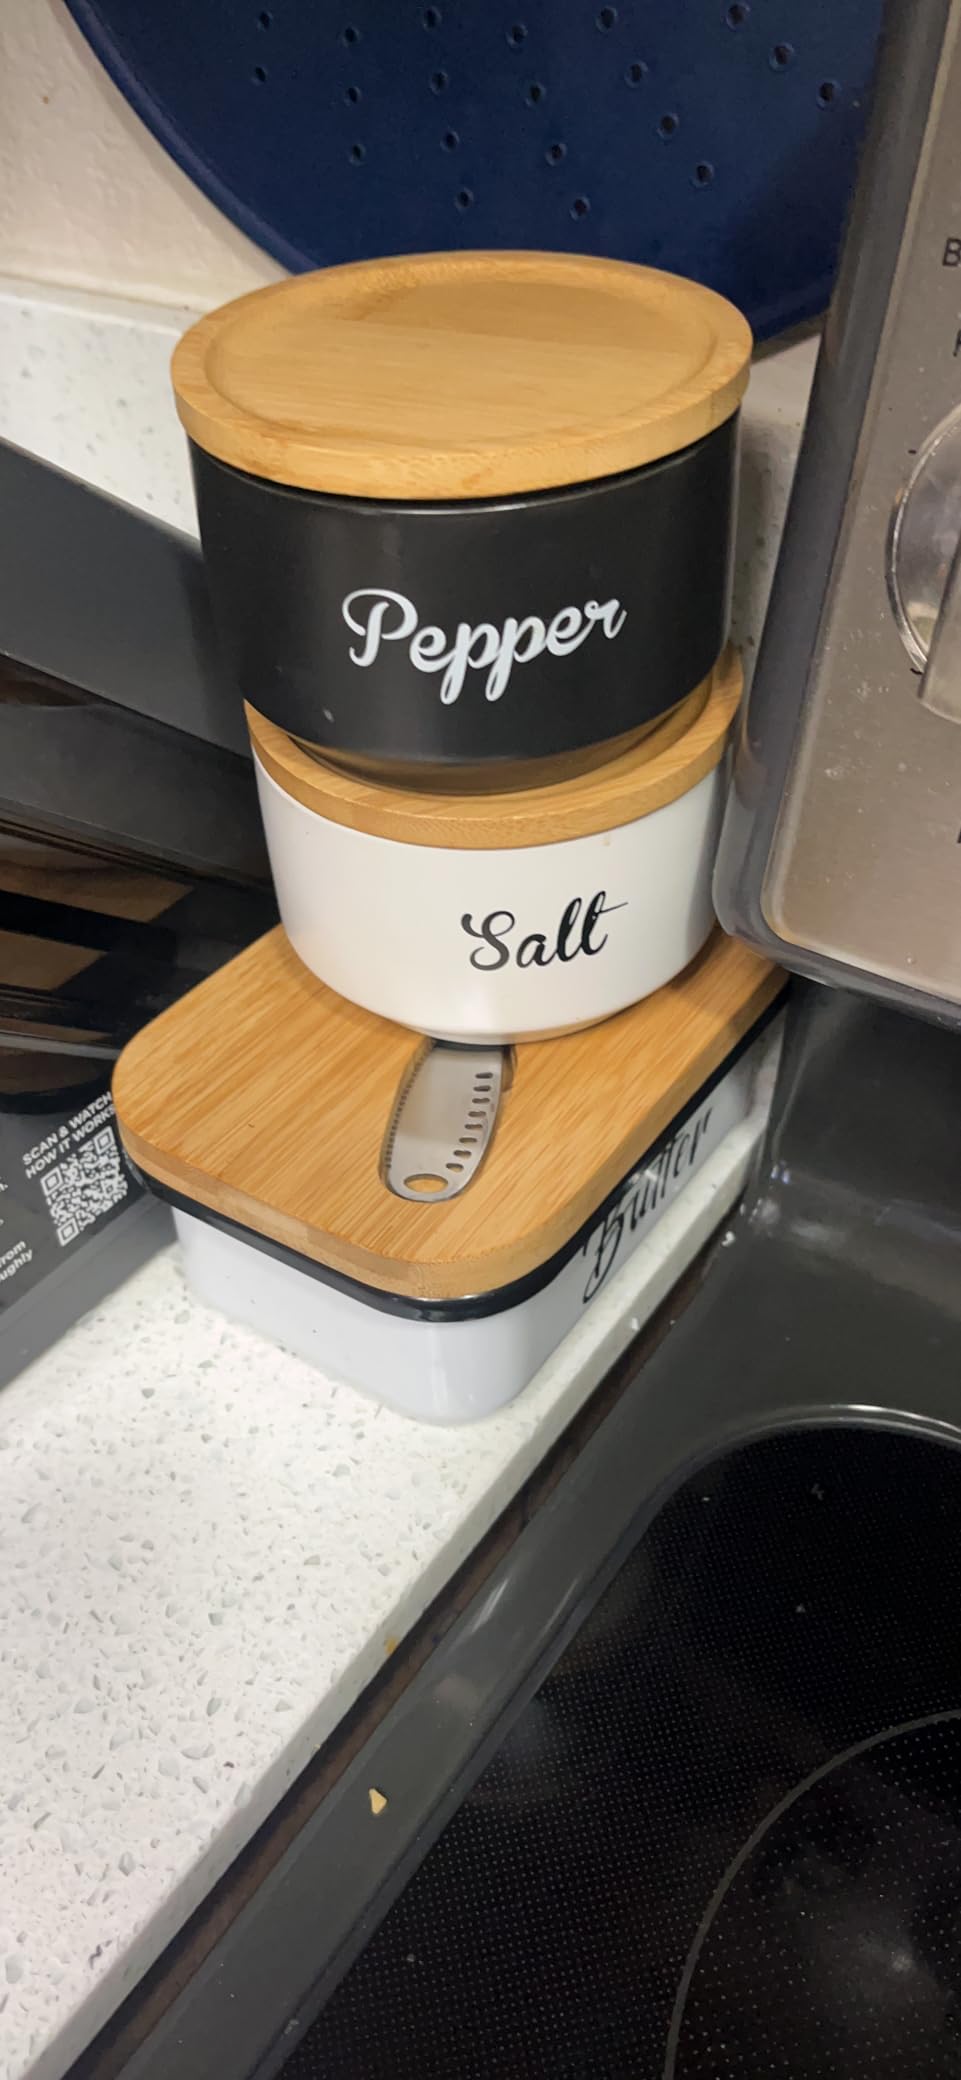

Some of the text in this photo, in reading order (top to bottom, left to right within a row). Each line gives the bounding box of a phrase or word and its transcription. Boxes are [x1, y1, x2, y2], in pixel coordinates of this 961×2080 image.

[342, 588, 628, 705] Pepper
[461, 890, 629, 971] Salt
[22, 1091, 112, 1166] SCAN & WATCH
[25, 1148, 57, 1179] HOW
[59, 1137, 71, 1153] IT
[581, 1107, 713, 1304] Butter
